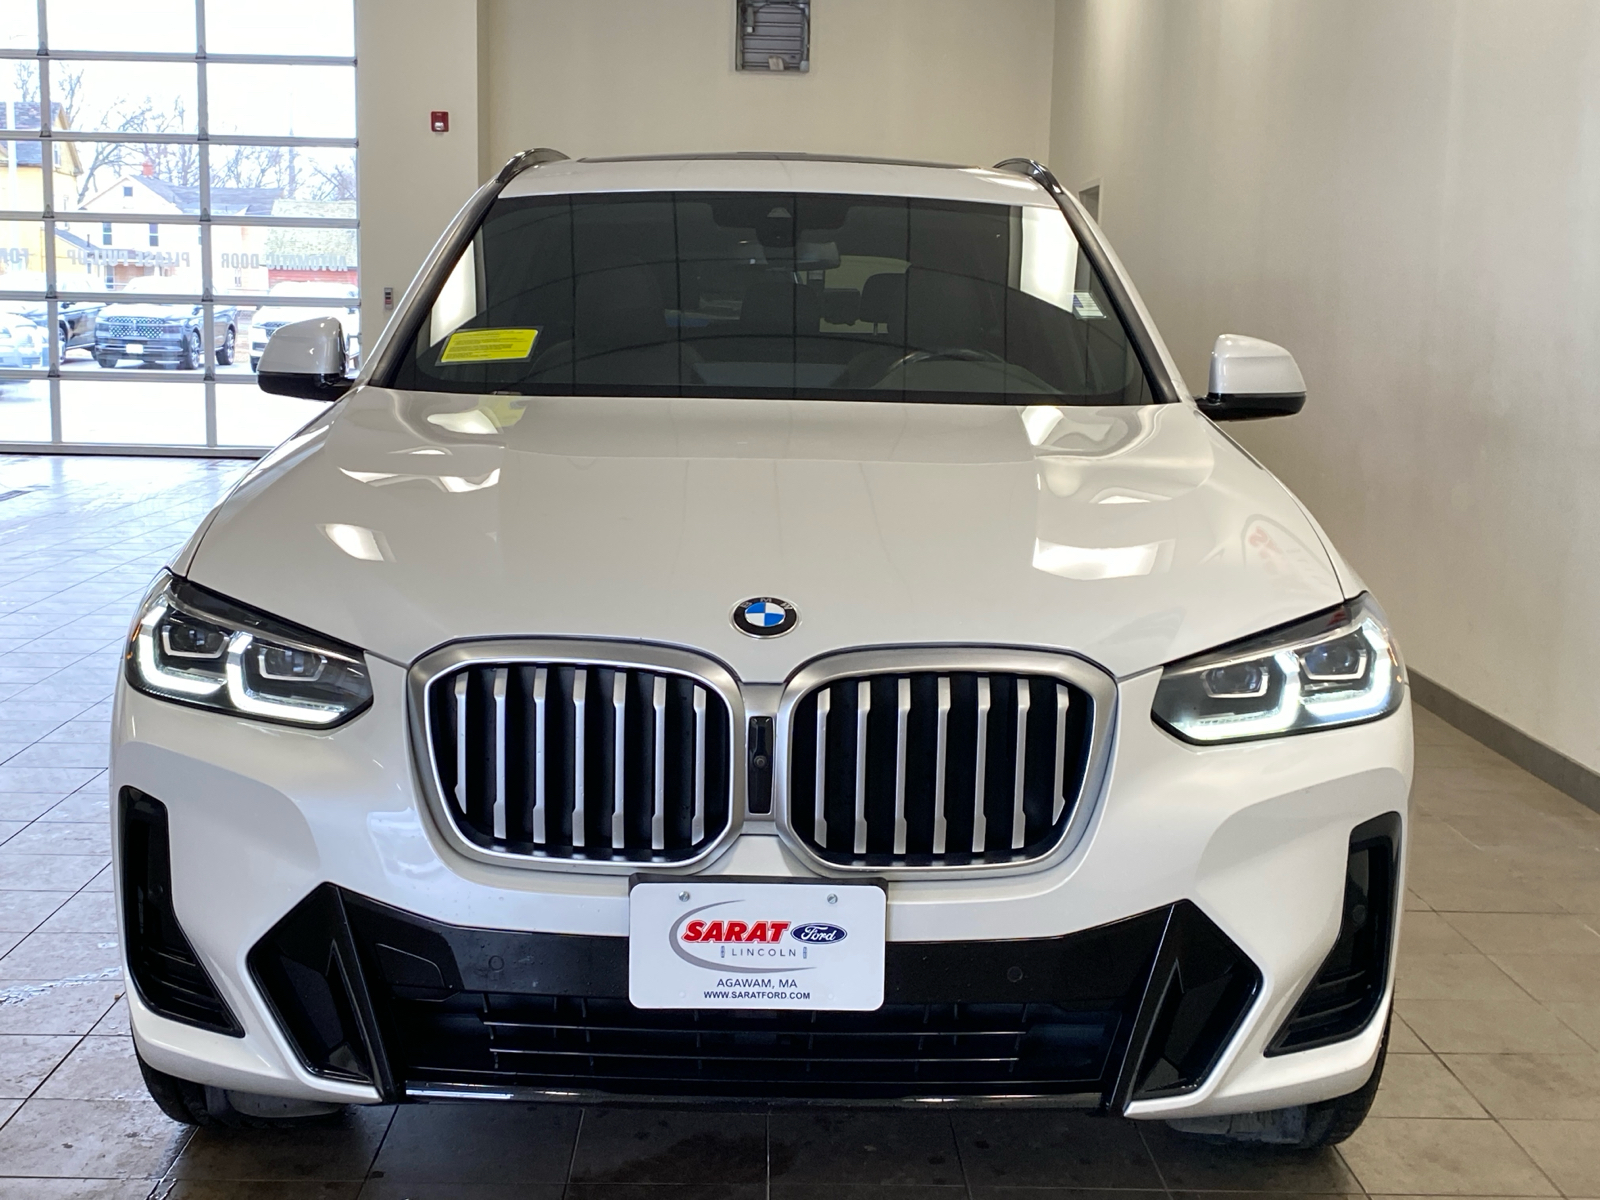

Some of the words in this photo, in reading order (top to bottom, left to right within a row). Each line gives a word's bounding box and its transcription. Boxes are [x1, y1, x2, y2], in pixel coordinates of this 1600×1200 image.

[740, 597, 793, 610] BMW
[682, 920, 791, 943] SARAT
[800, 924, 837, 941] Ford
[731, 948, 797, 957] LINCOLN
[716, 978, 775, 989] AGAWAM,
[778, 979, 798, 988] MA
[703, 991, 811, 1000] WWW.SARATFORD.COM
